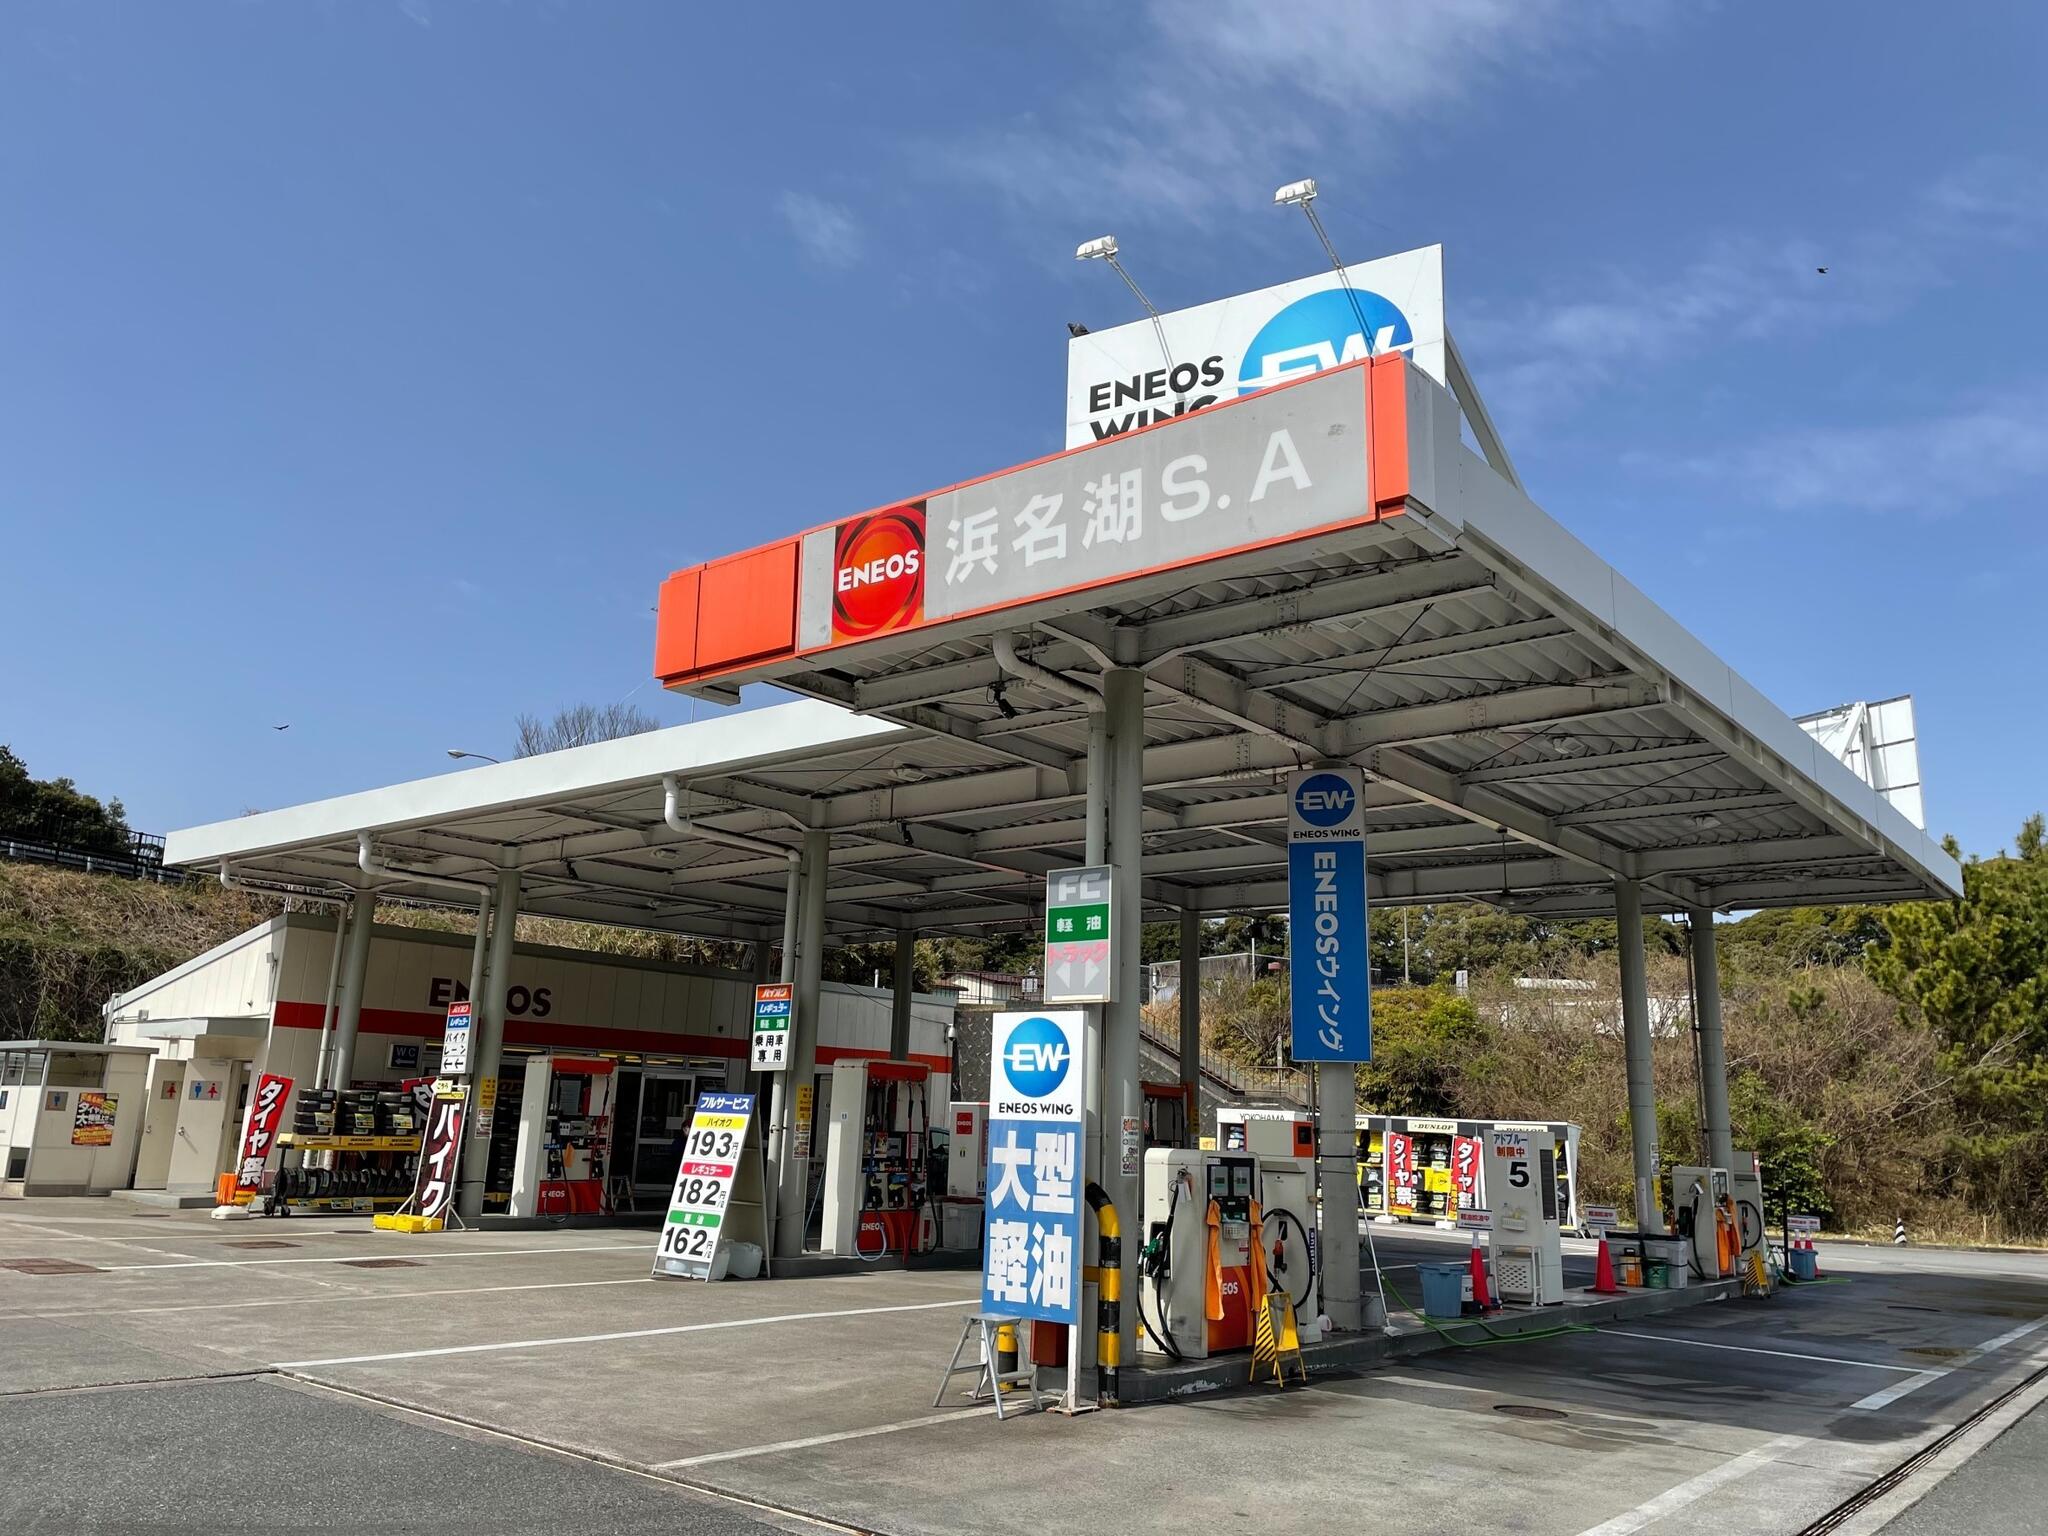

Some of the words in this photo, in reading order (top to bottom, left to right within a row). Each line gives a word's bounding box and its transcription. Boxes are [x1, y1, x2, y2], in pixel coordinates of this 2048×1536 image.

[1090, 355, 1224, 413] ENEOS
[838, 549, 919, 592] ENEOS
[1303, 790, 1348, 810] EW
[1293, 829, 1328, 839] ENEOS
[1331, 828, 1360, 837] WING
[1056, 915, 1102, 933] 軽油
[761, 987, 788, 998] ハイオク
[759, 1001, 788, 1013] レギュラー
[445, 1032, 466, 1043] バイク
[755, 1034, 784, 1047] 乗用車
[444, 1045, 466, 1055] レーン
[1012, 1043, 1064, 1072] EW
[700, 1096, 750, 1110] フルサービス
[998, 1102, 1038, 1114] ENEOS
[1040, 1103, 1073, 1115] WING
[706, 1116, 733, 1128] ハイオク
[240, 1080, 283, 1186] タイヤ祭
[1493, 1133, 1528, 1145] アドブルー
[690, 1130, 733, 1158] 193
[422, 1103, 460, 1217] バイク
[691, 1164, 724, 1175] レギュラー
[990, 1130, 1075, 1214] 大型
[1393, 1138, 1412, 1205] タイヤ祭
[1508, 1161, 1530, 1188] 5
[677, 1178, 721, 1206] 182
[664, 1226, 708, 1257] 162
[987, 1218, 1073, 1311] 軽油
